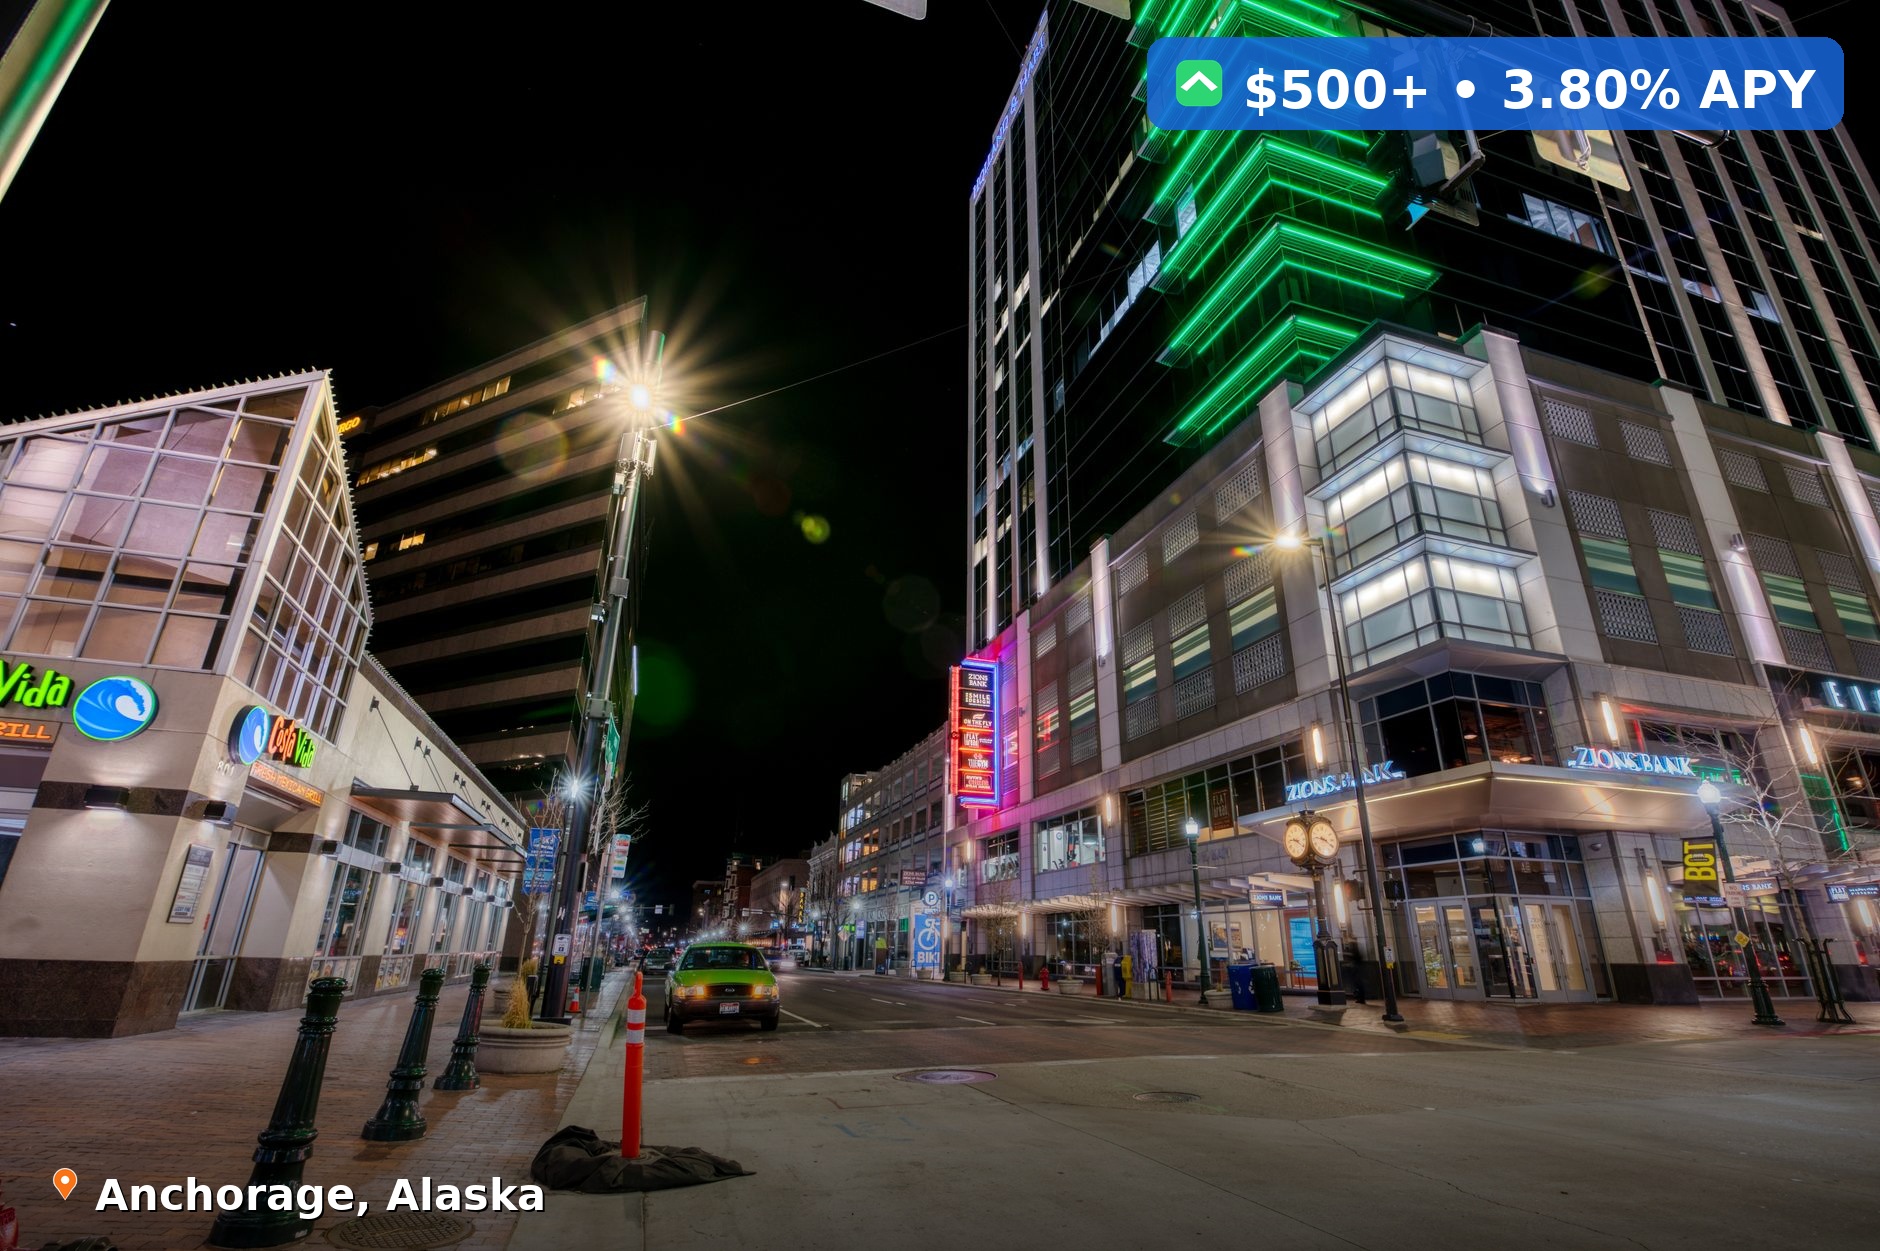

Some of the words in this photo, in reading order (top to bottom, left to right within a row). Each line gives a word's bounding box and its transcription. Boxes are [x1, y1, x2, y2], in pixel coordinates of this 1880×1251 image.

[968, 673, 988, 681] ZIONS
[969, 680, 987, 688] BANK
[268, 715, 296, 761] Costa
[295, 727, 315, 768] Vida
[254, 761, 276, 781] FRESH
[1574, 746, 1641, 771] ZIONS
[1641, 753, 1696, 777] BANK
[1286, 774, 1339, 801] ZIONS
